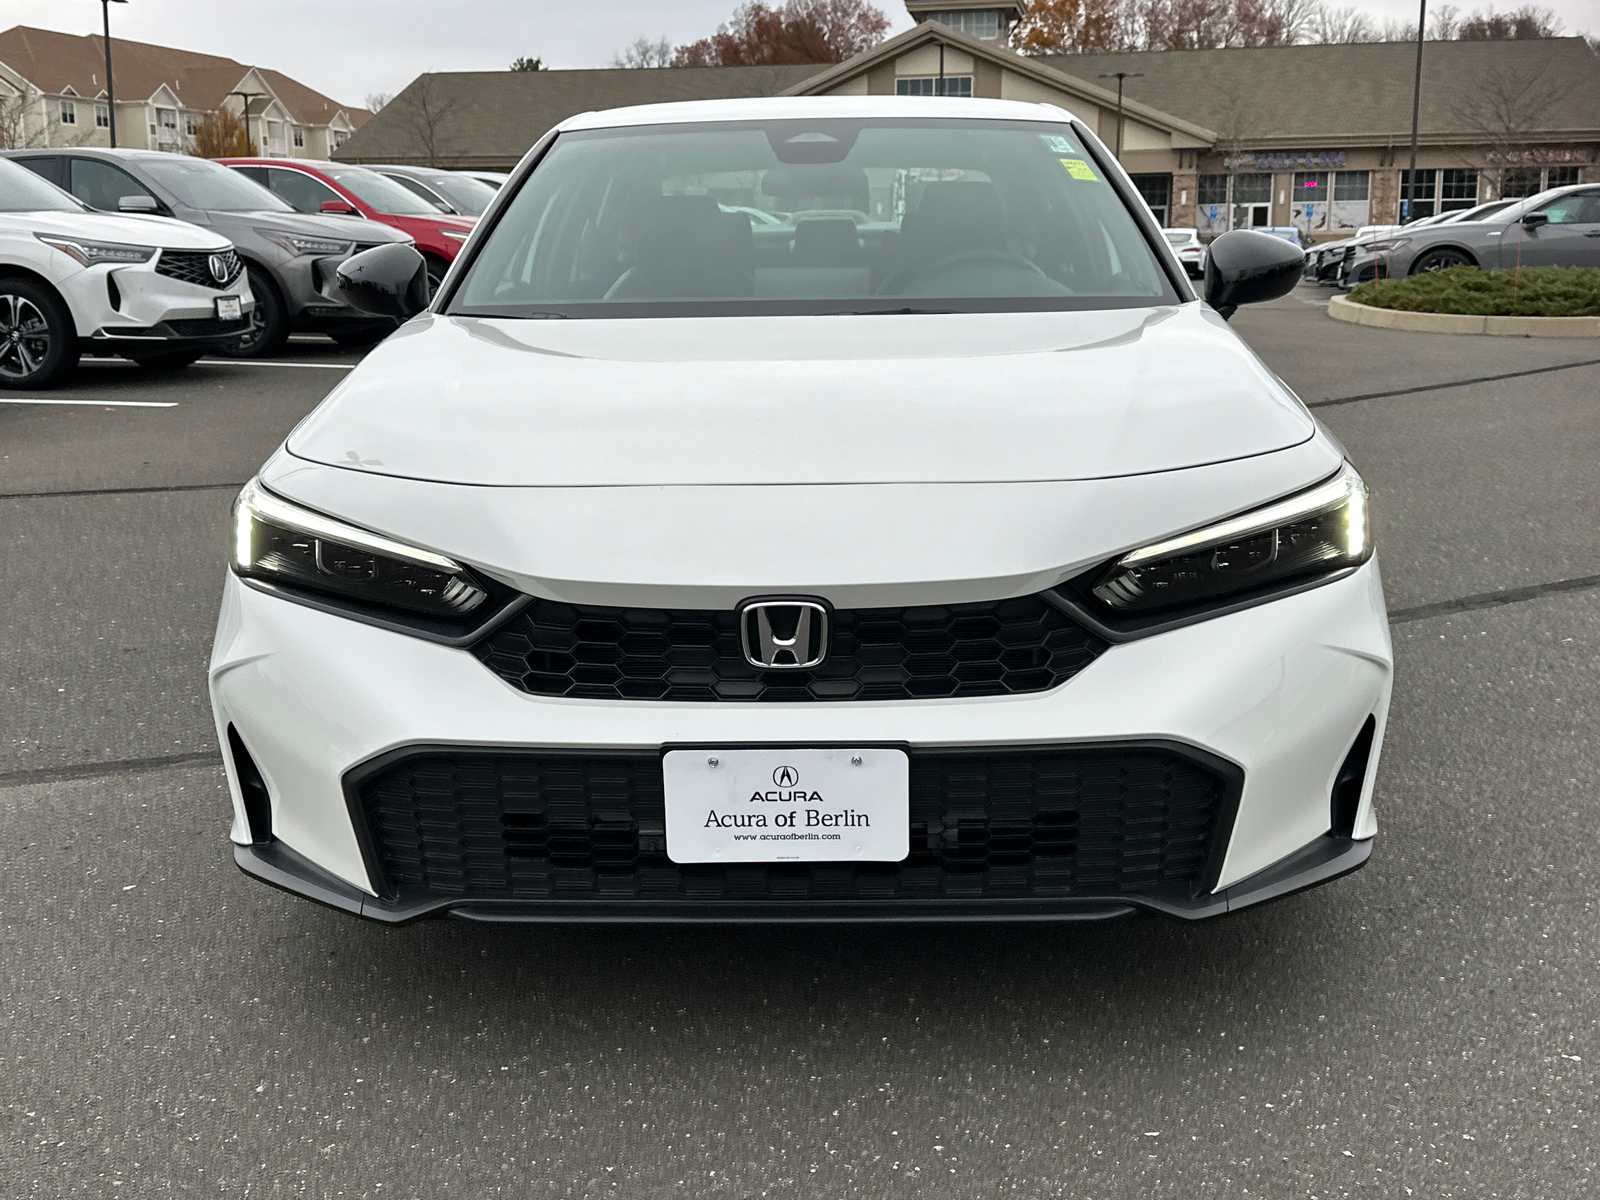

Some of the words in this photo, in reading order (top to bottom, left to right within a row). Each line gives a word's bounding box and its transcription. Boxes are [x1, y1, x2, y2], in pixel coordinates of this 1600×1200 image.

[1255, 152, 1298, 168] NAILS
[1304, 152, 1314, 167] &
[1318, 151, 1345, 167] SPA
[749, 791, 824, 802] ACURA
[704, 809, 768, 828] Acura
[774, 811, 797, 828] of
[804, 809, 871, 827] Berlin
[733, 833, 841, 842] www.acuraofberlin.com
